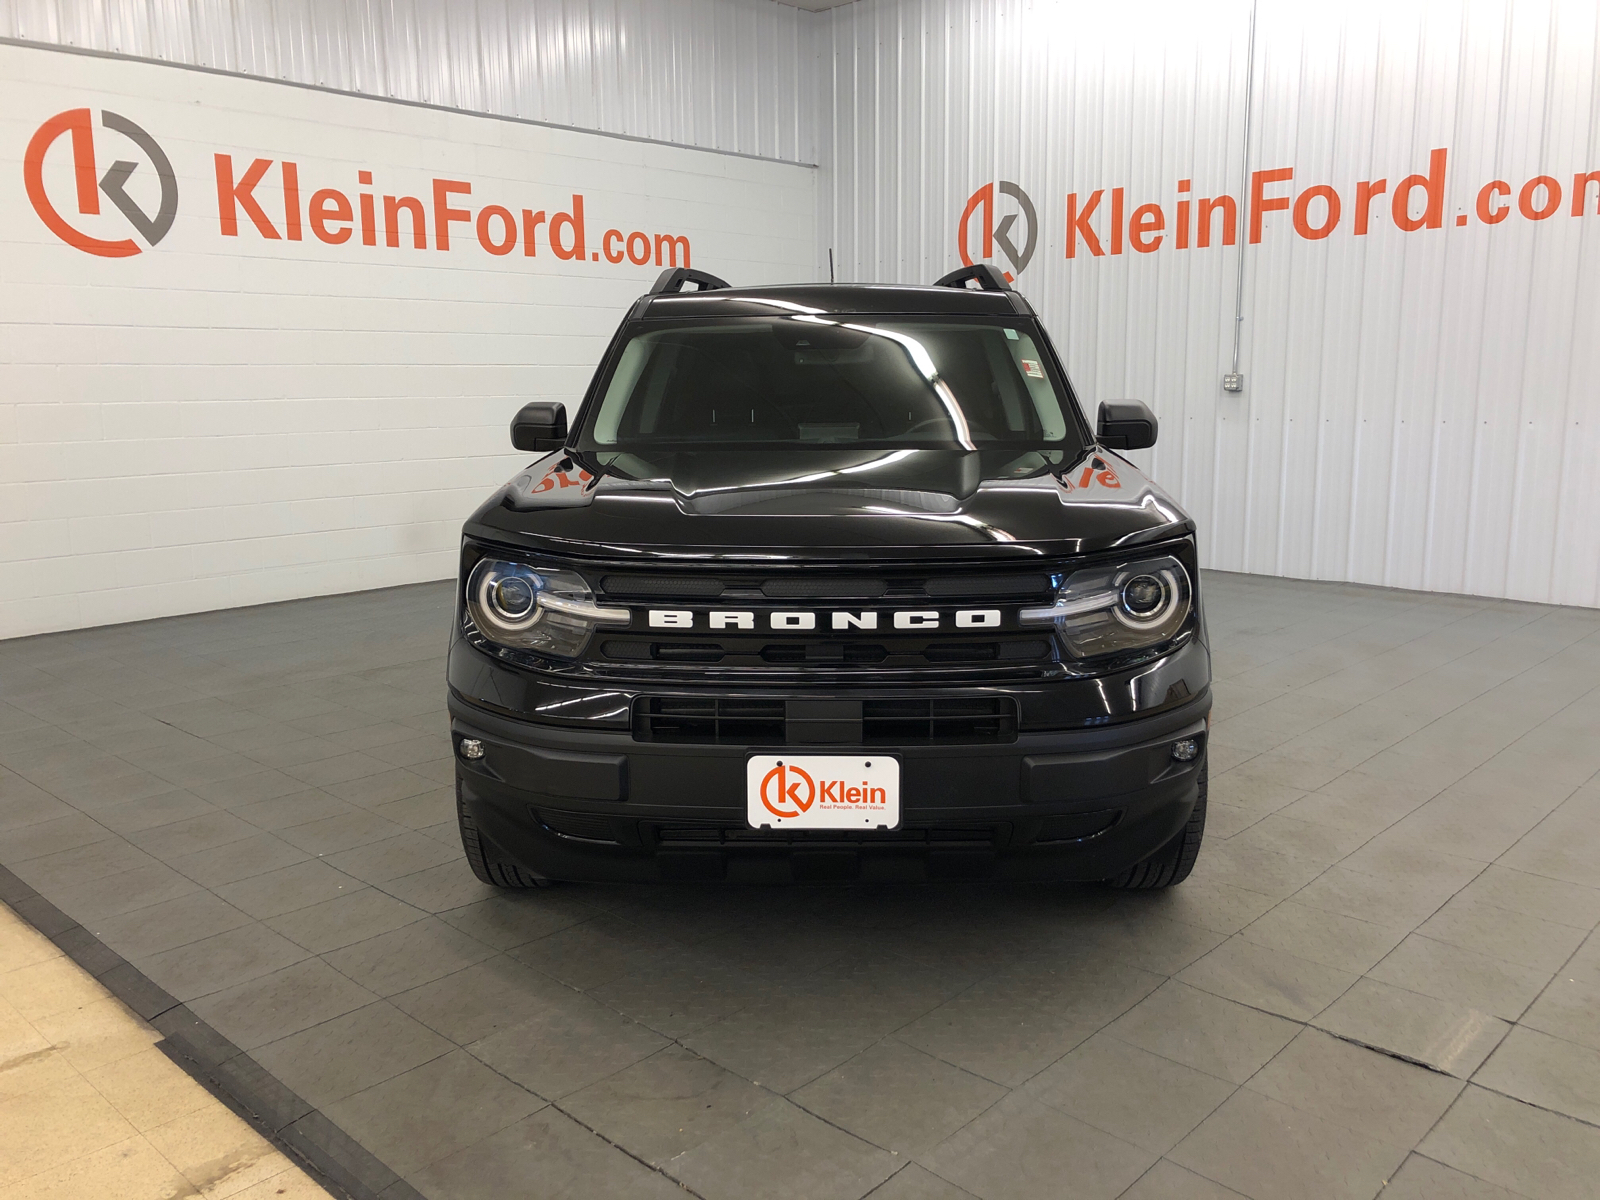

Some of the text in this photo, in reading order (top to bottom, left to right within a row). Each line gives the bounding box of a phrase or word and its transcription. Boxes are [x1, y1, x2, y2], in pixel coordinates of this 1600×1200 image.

[214, 153, 691, 269] KleinFord.com
[648, 609, 1001, 630] BRONCO
[819, 780, 887, 804] Klein
